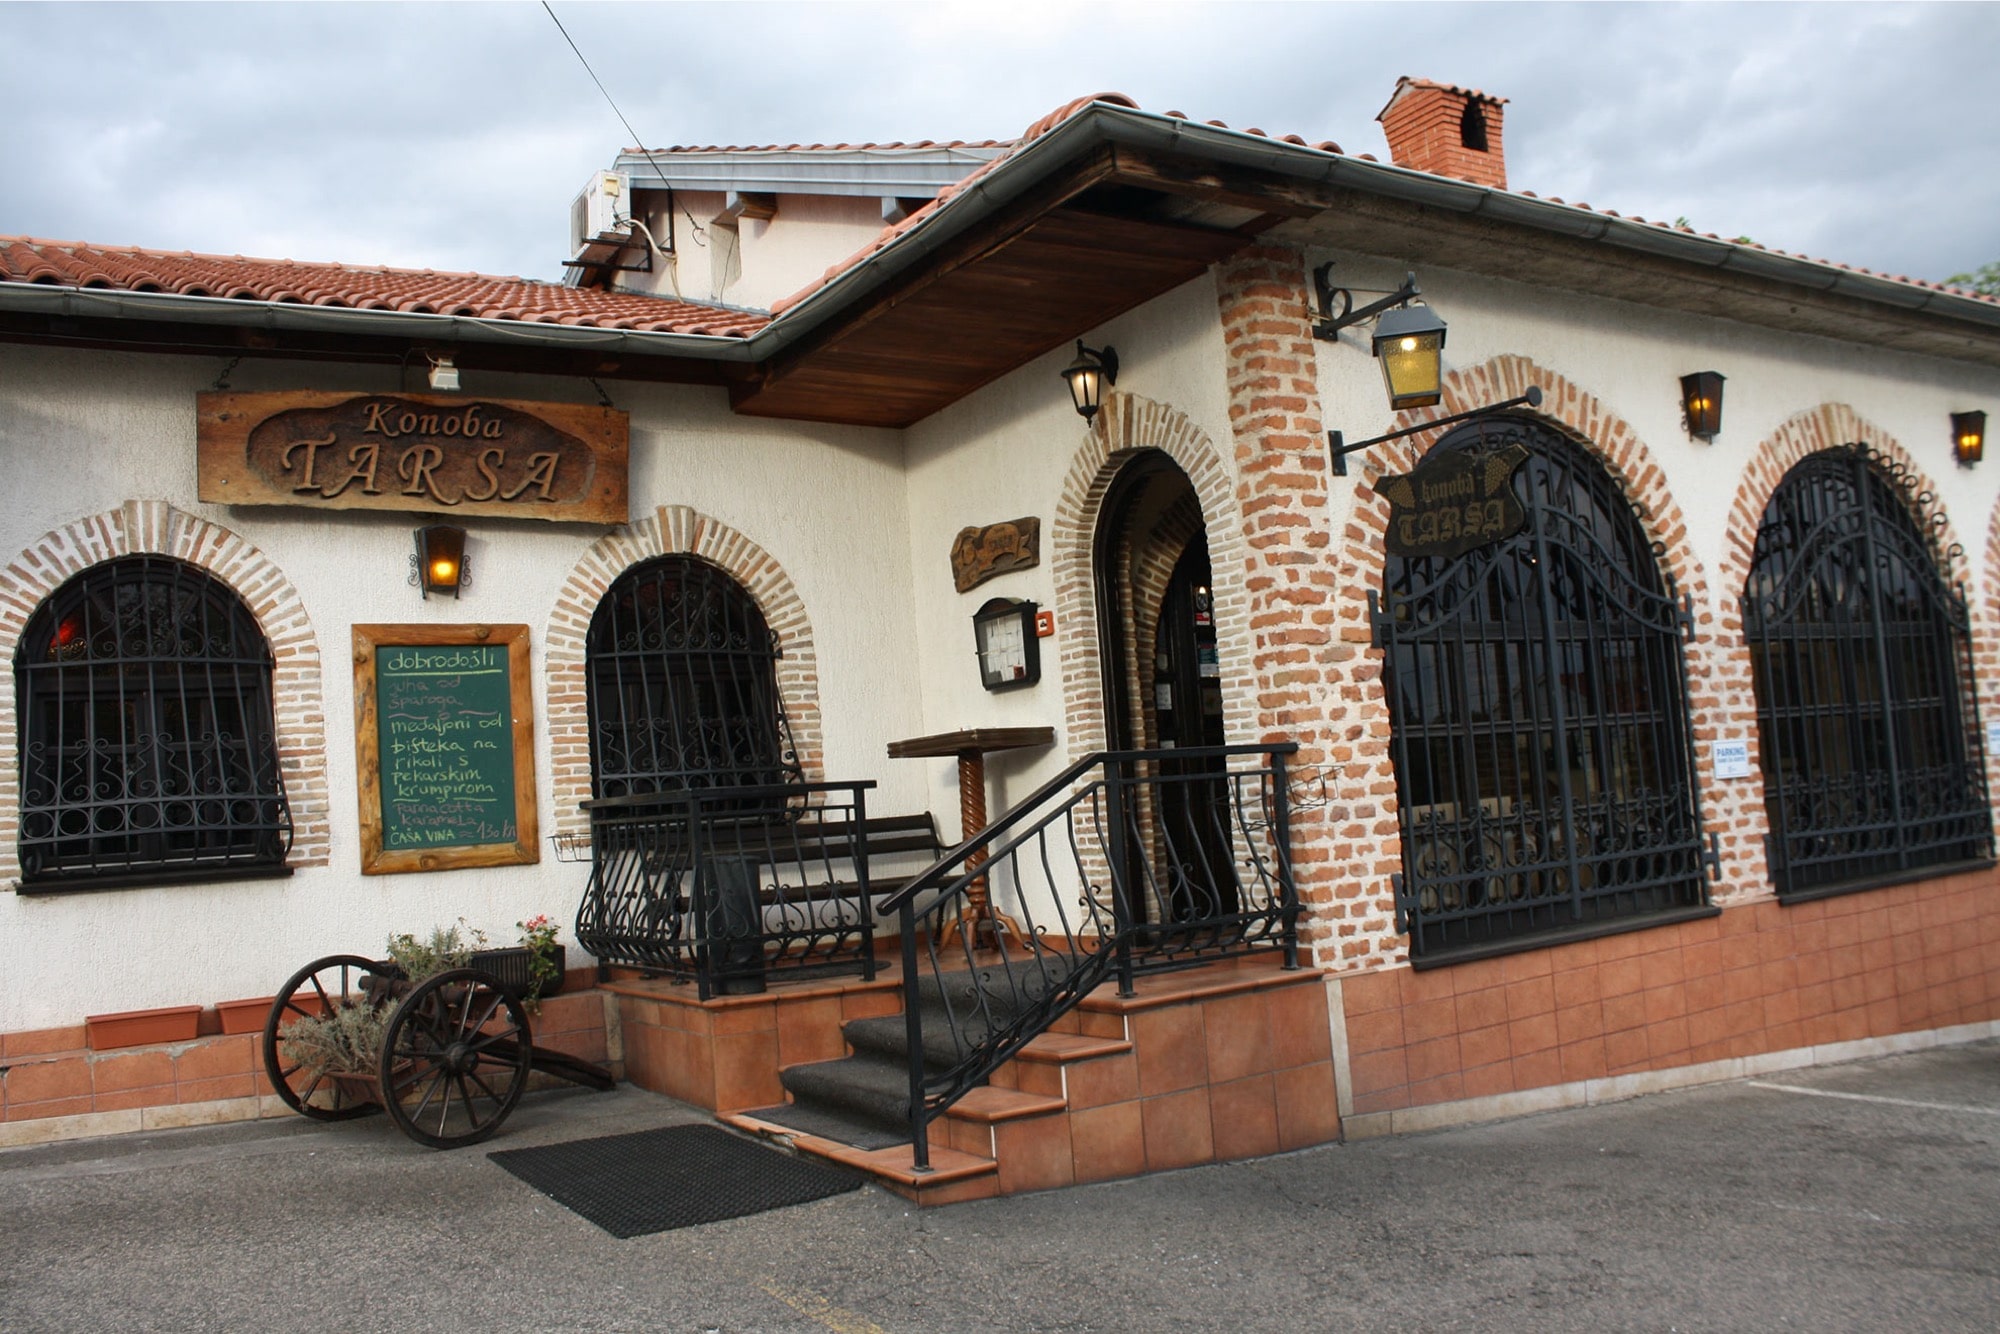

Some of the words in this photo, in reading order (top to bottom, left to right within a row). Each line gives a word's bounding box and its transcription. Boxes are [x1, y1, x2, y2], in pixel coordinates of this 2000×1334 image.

[364, 402, 503, 440] Konoba
[281, 432, 561, 505] TARSA
[1398, 499, 1505, 547] TARSA
[388, 647, 495, 671] dobrodošli
[436, 675, 461, 688] od
[391, 716, 471, 737] medaljoni
[478, 712, 502, 728] od
[473, 740, 498, 750] na
[391, 764, 482, 785] pekarskim
[398, 784, 495, 799] krumpirom
[425, 829, 456, 842] VINA
